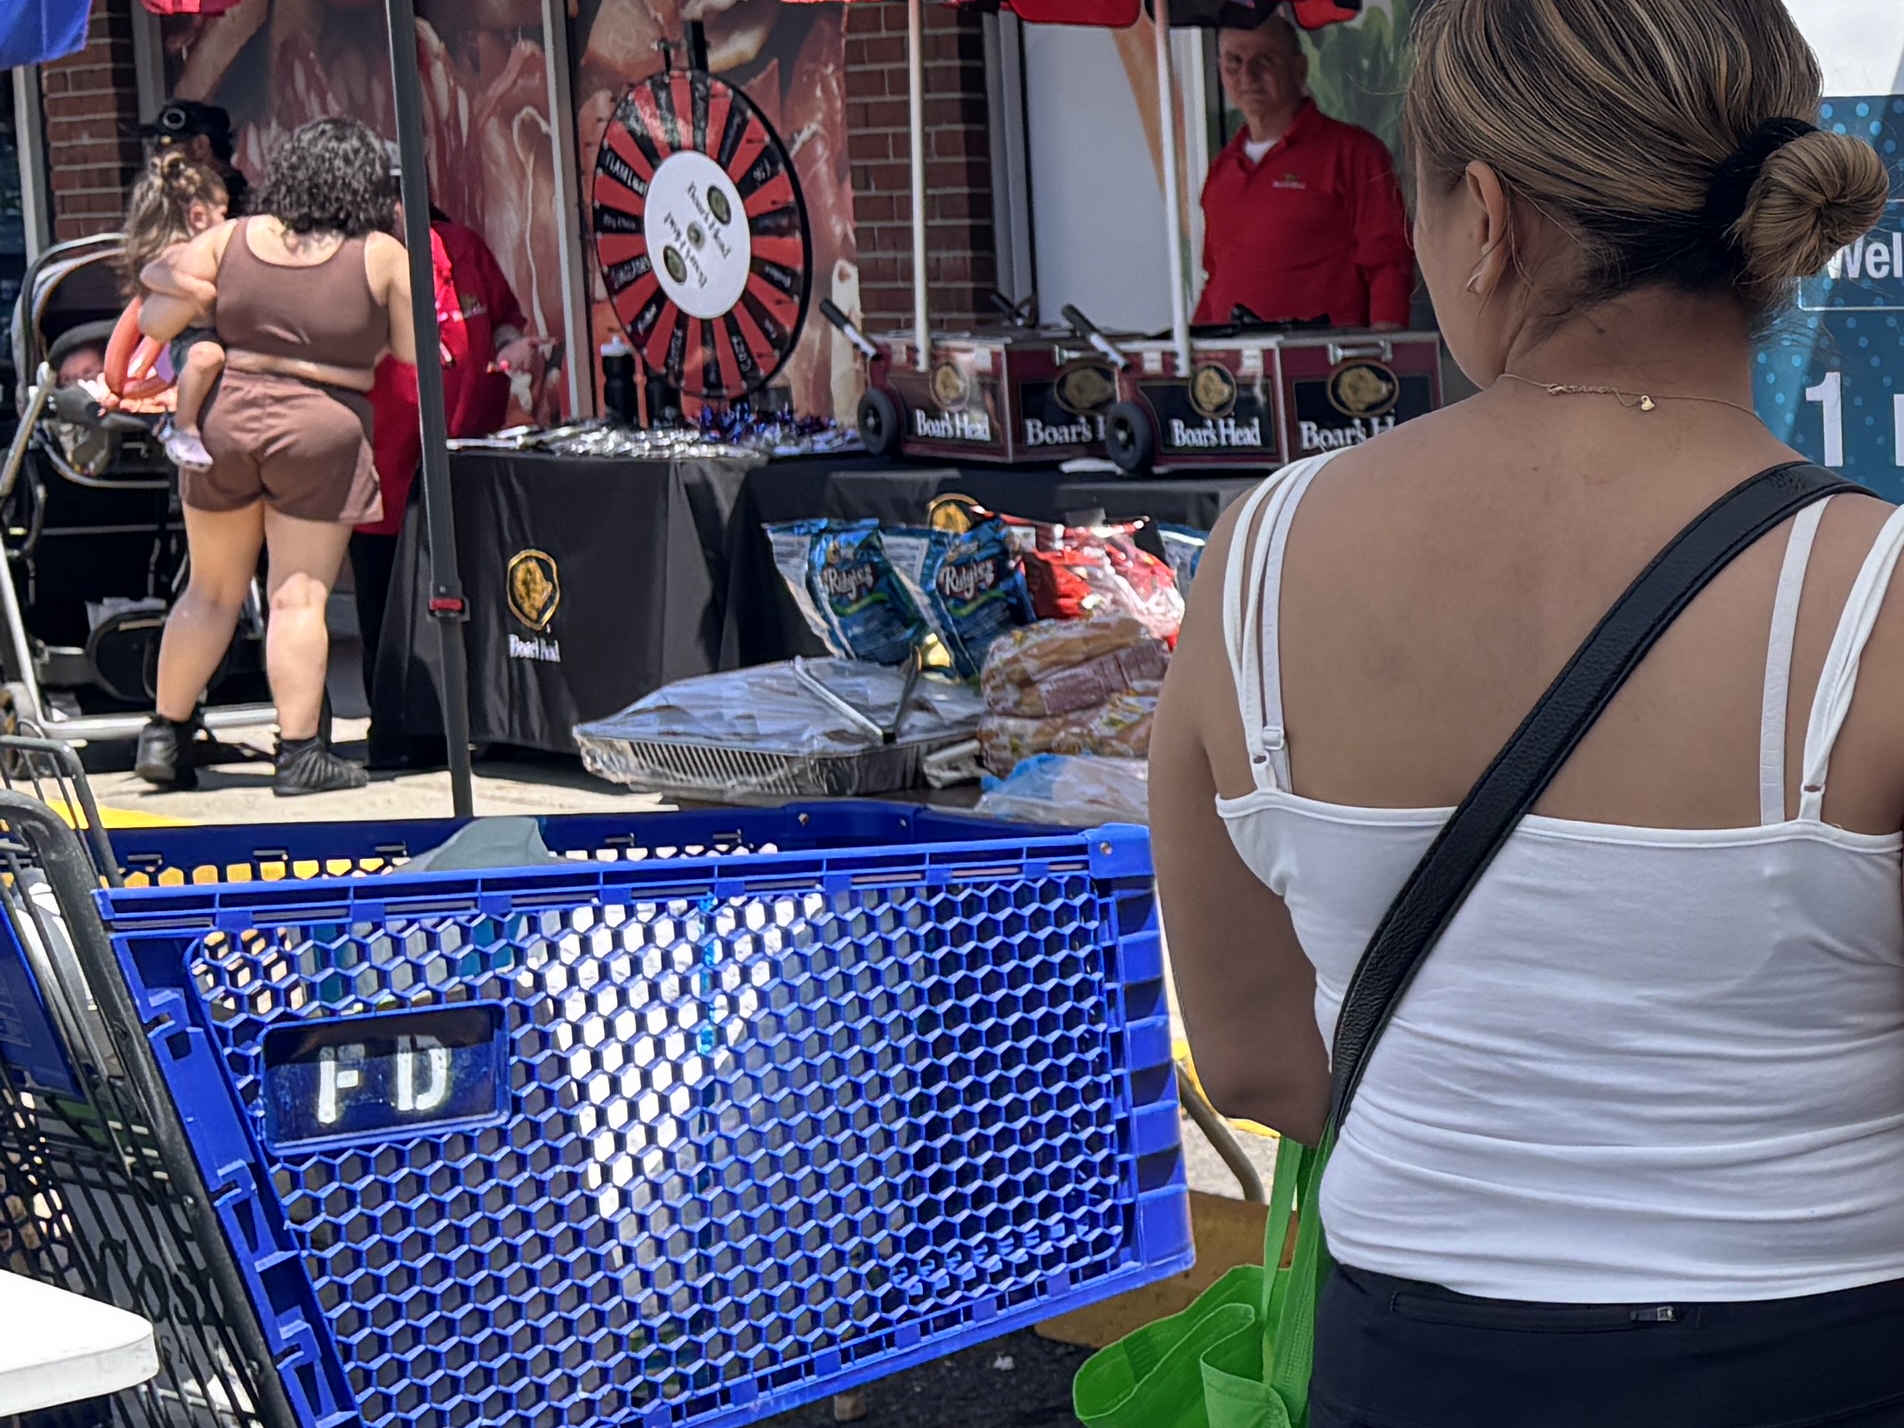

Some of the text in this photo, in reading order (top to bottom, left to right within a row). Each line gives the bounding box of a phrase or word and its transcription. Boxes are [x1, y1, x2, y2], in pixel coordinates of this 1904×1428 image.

[916, 409, 953, 438] Boar's
[1025, 414, 1092, 446] Boar's
[1169, 417, 1262, 447] Boar's Head
[1805, 372, 1843, 466] 1
